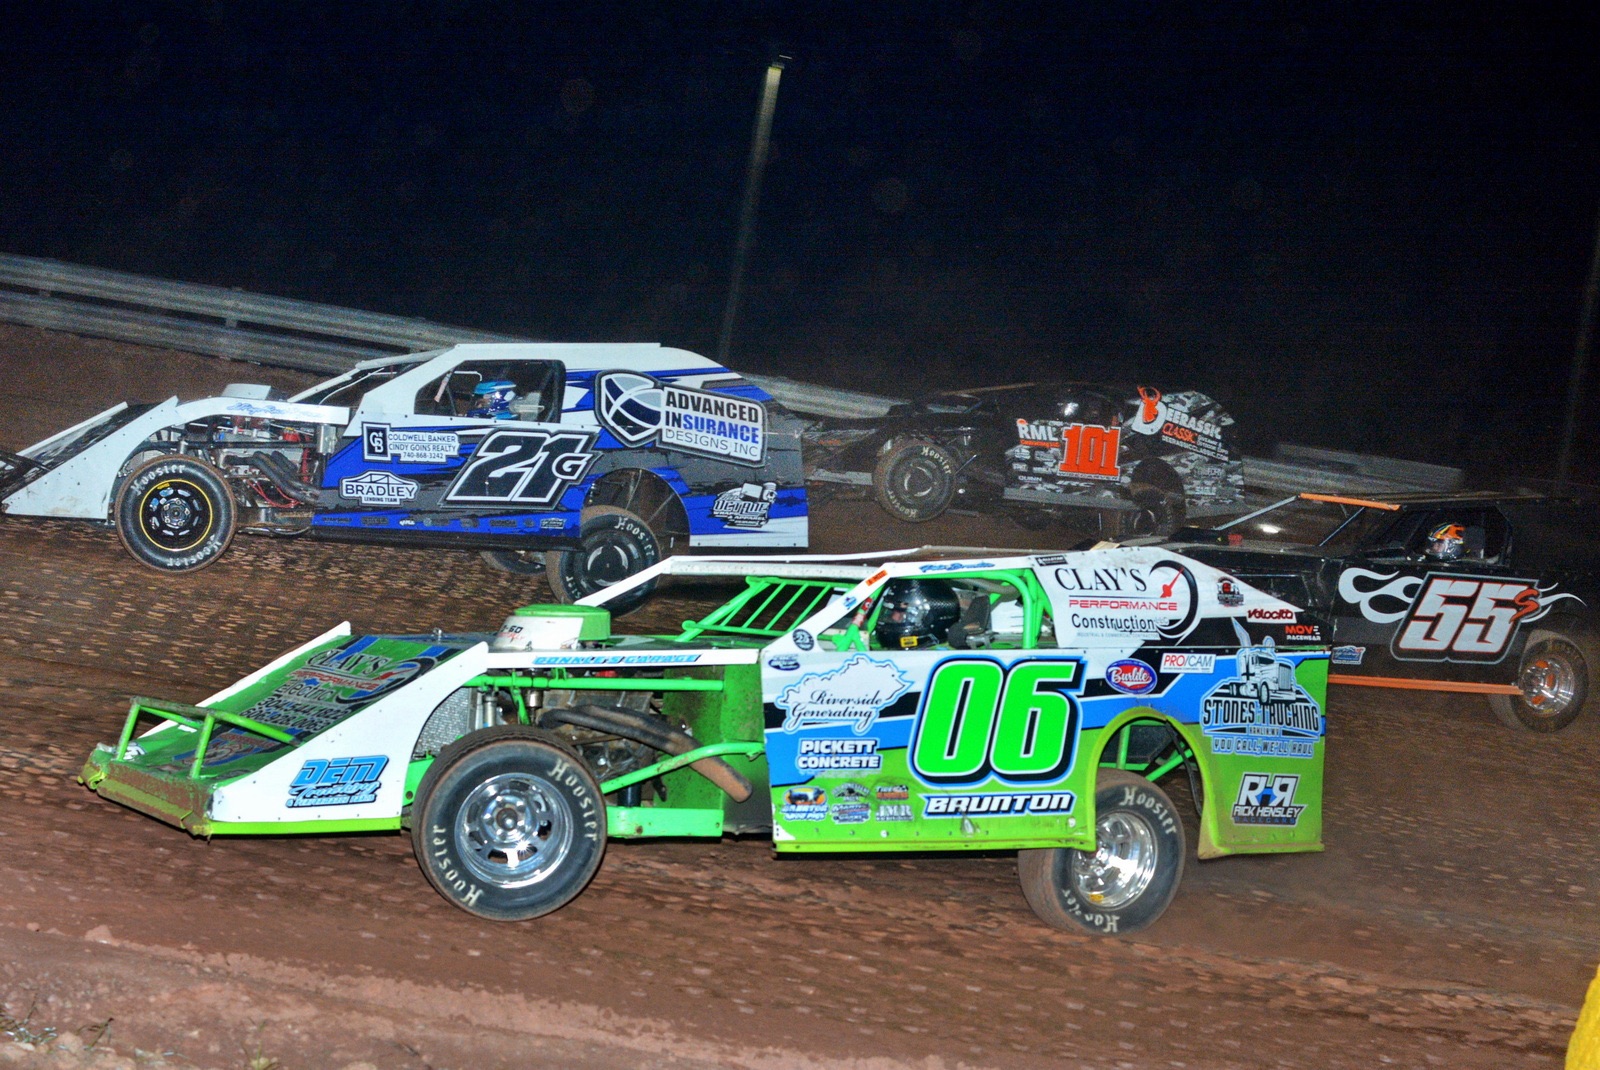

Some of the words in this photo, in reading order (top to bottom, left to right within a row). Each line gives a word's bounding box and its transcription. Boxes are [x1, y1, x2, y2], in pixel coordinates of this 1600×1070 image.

[666, 391, 758, 423] ADVANCED
[388, 433, 426, 442] COLDWELL
[428, 435, 456, 443] BANKER
[665, 411, 758, 444] INSURANCE
[1017, 424, 1059, 441] RML
[388, 443, 409, 451] CINDY
[410, 444, 431, 452] GOINS
[665, 427, 728, 450] DESIGNS
[734, 442, 758, 457] INC
[1059, 422, 1121, 476] 101
[344, 482, 416, 498] BRADLEY
[1055, 567, 1147, 592] CLAY'S
[1069, 600, 1178, 611] PERFORMANCE
[1071, 613, 1155, 632] Construction
[306, 649, 391, 675] CLAY'S
[624, 654, 702, 664] GARAGE
[276, 681, 334, 703] Electric
[290, 670, 381, 692] PERFORMANCE
[808, 690, 882, 706] Riverside
[788, 703, 873, 731] Generating
[913, 660, 1079, 777] 06
[1203, 700, 1255, 725] STONES
[1261, 702, 1319, 732] TRUCKING
[800, 740, 877, 754] PICKETT
[1213, 738, 1232, 750] YOU
[1262, 741, 1288, 753] WE'LL
[1291, 743, 1313, 755] HAUL
[798, 756, 880, 769] CONCRETE
[546, 759, 598, 842] Hoosier
[926, 794, 1072, 814] BRUNTON
[1120, 786, 1178, 835] Hoosier
[1234, 807, 1257, 816] RICK
[1256, 807, 1300, 818] HENSLEY
[432, 824, 484, 907] Hoosier
